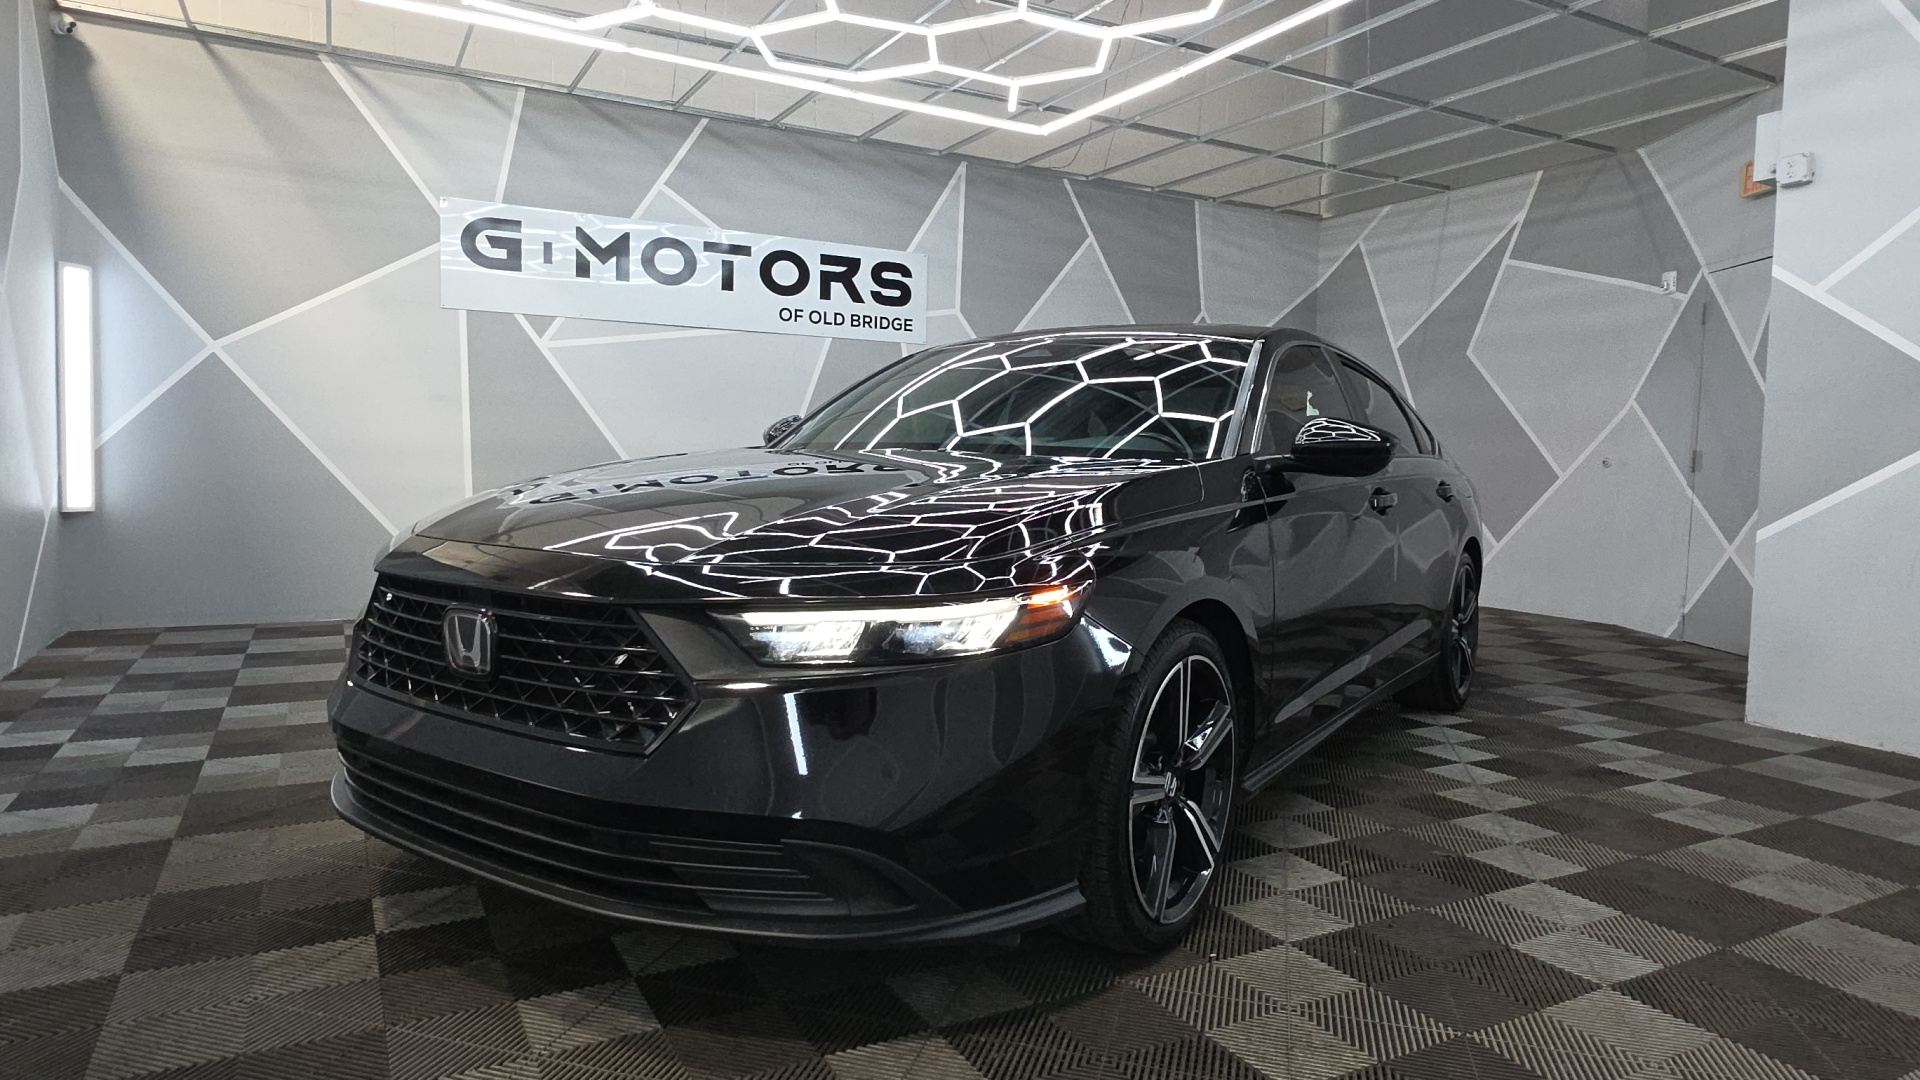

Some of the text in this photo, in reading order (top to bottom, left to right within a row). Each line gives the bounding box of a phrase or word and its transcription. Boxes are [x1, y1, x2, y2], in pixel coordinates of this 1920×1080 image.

[575, 226, 913, 308] MOTORS
[778, 307, 914, 332] OF OLD BRIDGE
